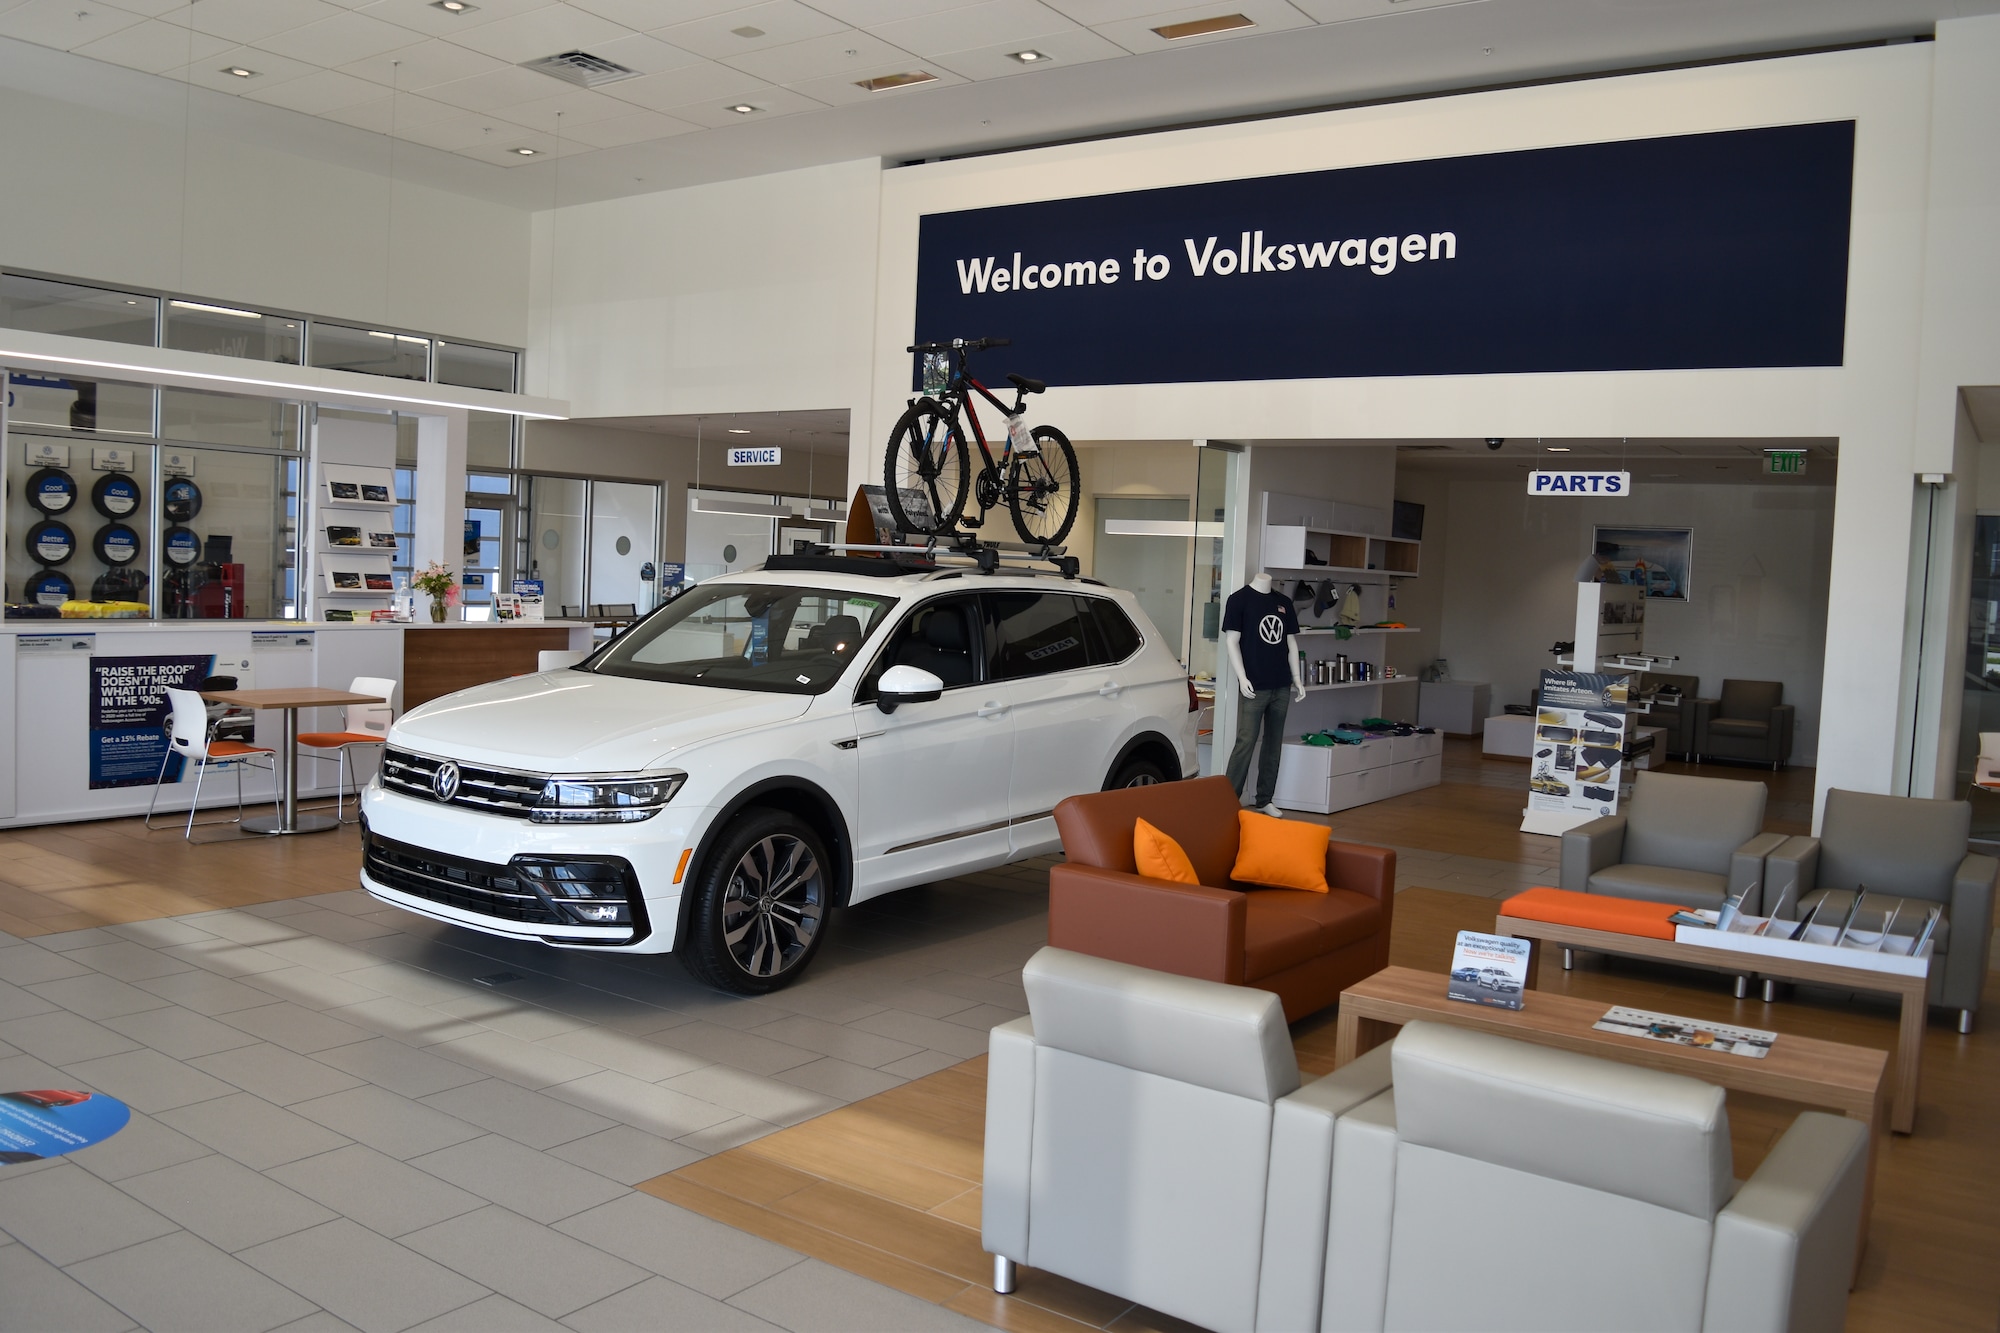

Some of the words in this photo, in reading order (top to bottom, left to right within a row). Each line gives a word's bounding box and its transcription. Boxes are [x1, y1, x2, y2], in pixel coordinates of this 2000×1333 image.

[957, 252, 1121, 295] Welcome
[1133, 248, 1171, 281] to
[1184, 230, 1458, 276] Volkswagen
[733, 450, 775, 463] SERVICE
[1771, 452, 1800, 473] EXIT
[1536, 475, 1622, 492] PARTS
[42, 535, 64, 543] Better
[95, 666, 135, 677] "RAISE
[136, 665, 157, 676] THE
[159, 664, 195, 675] ROOF"
[101, 676, 149, 687] DOESN'T
[151, 675, 184, 685] MEAN
[1544, 678, 1566, 686] Where
[101, 686, 136, 697] WHAT
[138, 686, 147, 696] IT
[149, 685, 167, 695] DID
[1544, 685, 1570, 693] imitates
[1570, 687, 1595, 695] Arteon.
[101, 696, 113, 707] IN
[116, 696, 137, 706] THE
[139, 695, 164, 705] '90s.
[121, 735, 136, 743] 15%
[136, 734, 159, 742] Rebate
[1464, 935, 1499, 945] Volkswagen
[1500, 941, 1521, 949] quality
[1472, 943, 1506, 953] exceptional
